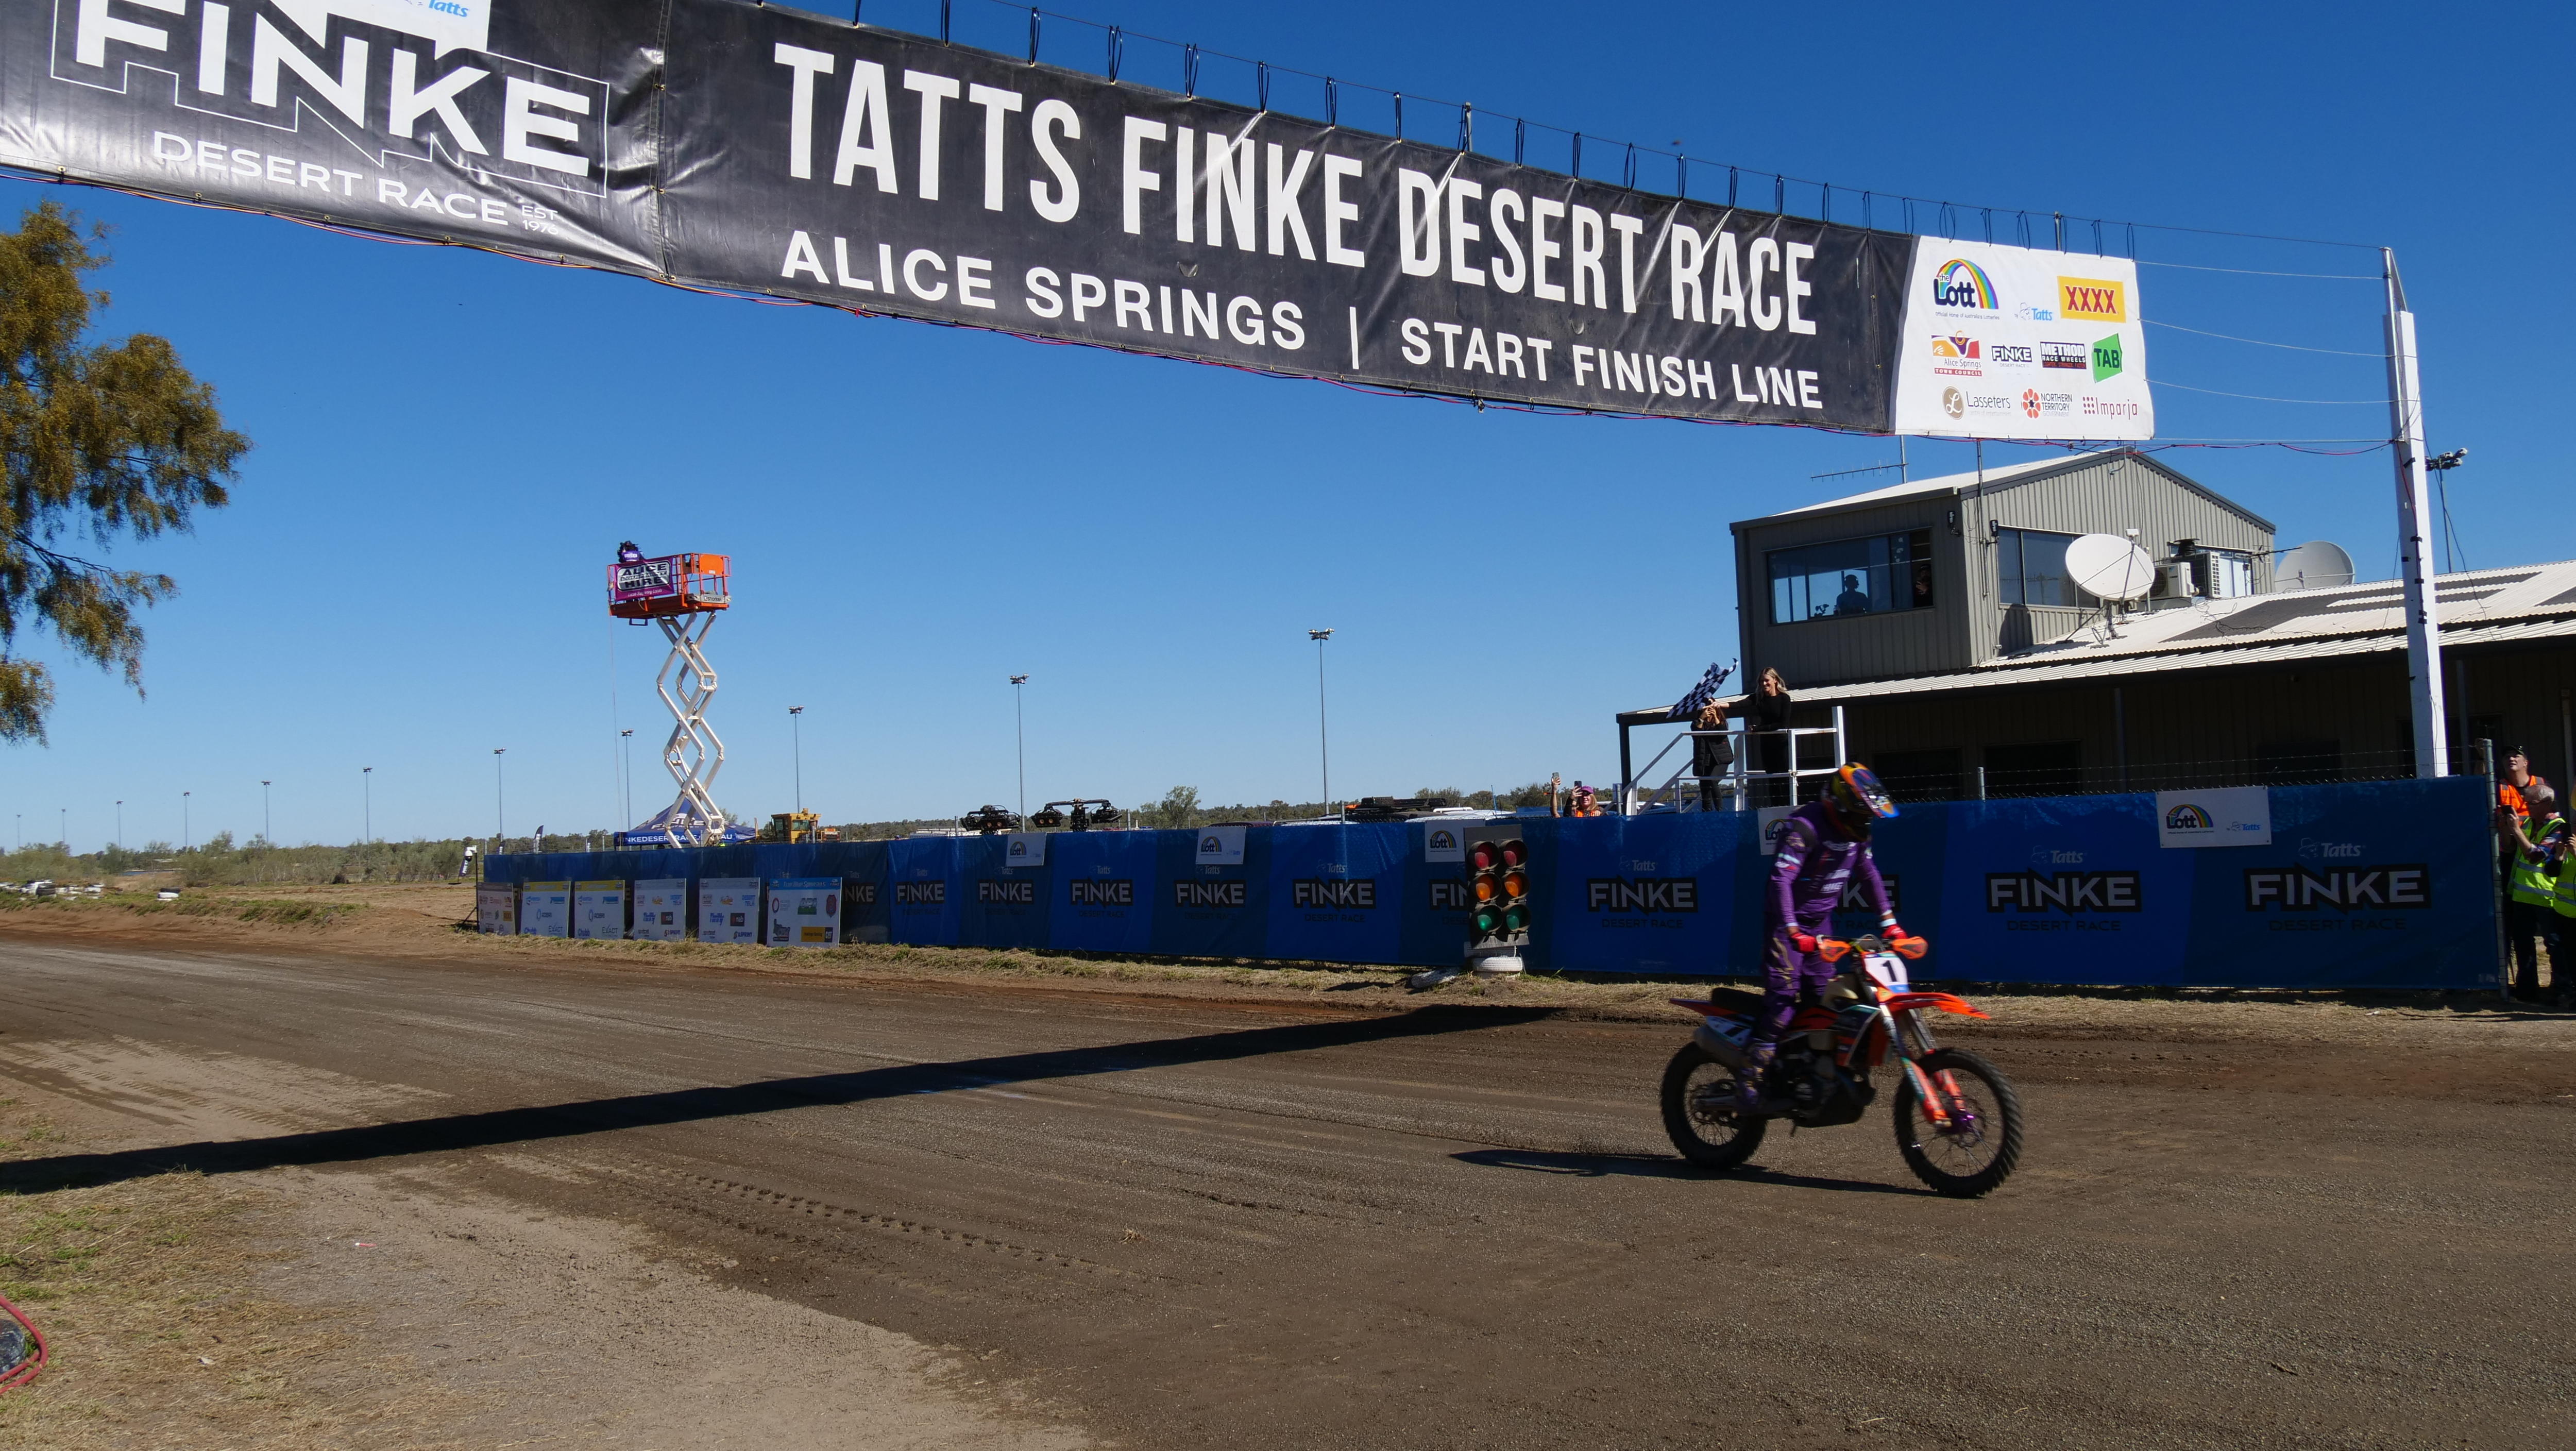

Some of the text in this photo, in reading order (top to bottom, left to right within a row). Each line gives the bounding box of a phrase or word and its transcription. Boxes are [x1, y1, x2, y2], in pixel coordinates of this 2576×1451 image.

[76, 0, 590, 177] FINKE
[153, 131, 509, 226] DESERT RACE
[774, 42, 1817, 335] TATTS FINKE DESERT RACE
[521, 205, 558, 222] EST
[521, 219, 560, 235] 1976
[1933, 278, 1976, 308] Lott
[2064, 285, 2117, 314] XXXX
[781, 230, 996, 309] ALICE
[1025, 266, 1305, 350] SPRINGS
[1401, 318, 1553, 381] START
[1572, 345, 1717, 400] FINISH
[1731, 363, 1823, 409] LINE
[2031, 308, 2053, 320] Tatts
[1992, 347, 2031, 361] FINKE
[2041, 343, 2084, 357] METHOD
[1944, 358, 1981, 369] Alice Springs
[2094, 348, 2120, 368] TAB
[1966, 391, 2011, 409] Lasseters
[2041, 393, 2073, 402] NORTHERN
[2041, 402, 2070, 411] TERRITORY
[2095, 397, 2138, 420] Imparja
[622, 563, 667, 576] ALICE
[624, 576, 663, 588] HIRE
[2166, 815, 2196, 829] Lott
[1765, 829, 1781, 840] Lo
[1201, 843, 1216, 853] Lott
[1430, 838, 1448, 849] Lott
[2321, 842, 2362, 857] Tatts
[2050, 850, 2083, 864] Tatts
[1001, 866, 1014, 874] Tatts
[1096, 865, 1111, 874] Tatts
[1205, 865, 1221, 874] Tatts
[1327, 863, 1347, 874] Tatts
[1632, 859, 1656, 871] Tatts
[844, 885, 875, 902] NKE
[897, 883, 944, 902] FINKE
[979, 883, 1032, 902] FINKE
[1072, 883, 1132, 902] FINKE
[1176, 883, 1245, 904] FINKE
[1295, 883, 1374, 905] FINKE
[1432, 883, 1468, 907] FIN
[1590, 882, 1694, 908] FINKE
[1991, 876, 2136, 907] FINKE
[2250, 870, 2424, 906] FINKE
[1304, 914, 1365, 923] DESERT RACE
[1602, 919, 1684, 928] DESERT RACE
[2007, 919, 2121, 931] DESERT RACE
[2269, 918, 2407, 931] DESERT RACE
[1882, 960, 1899, 982] 1
